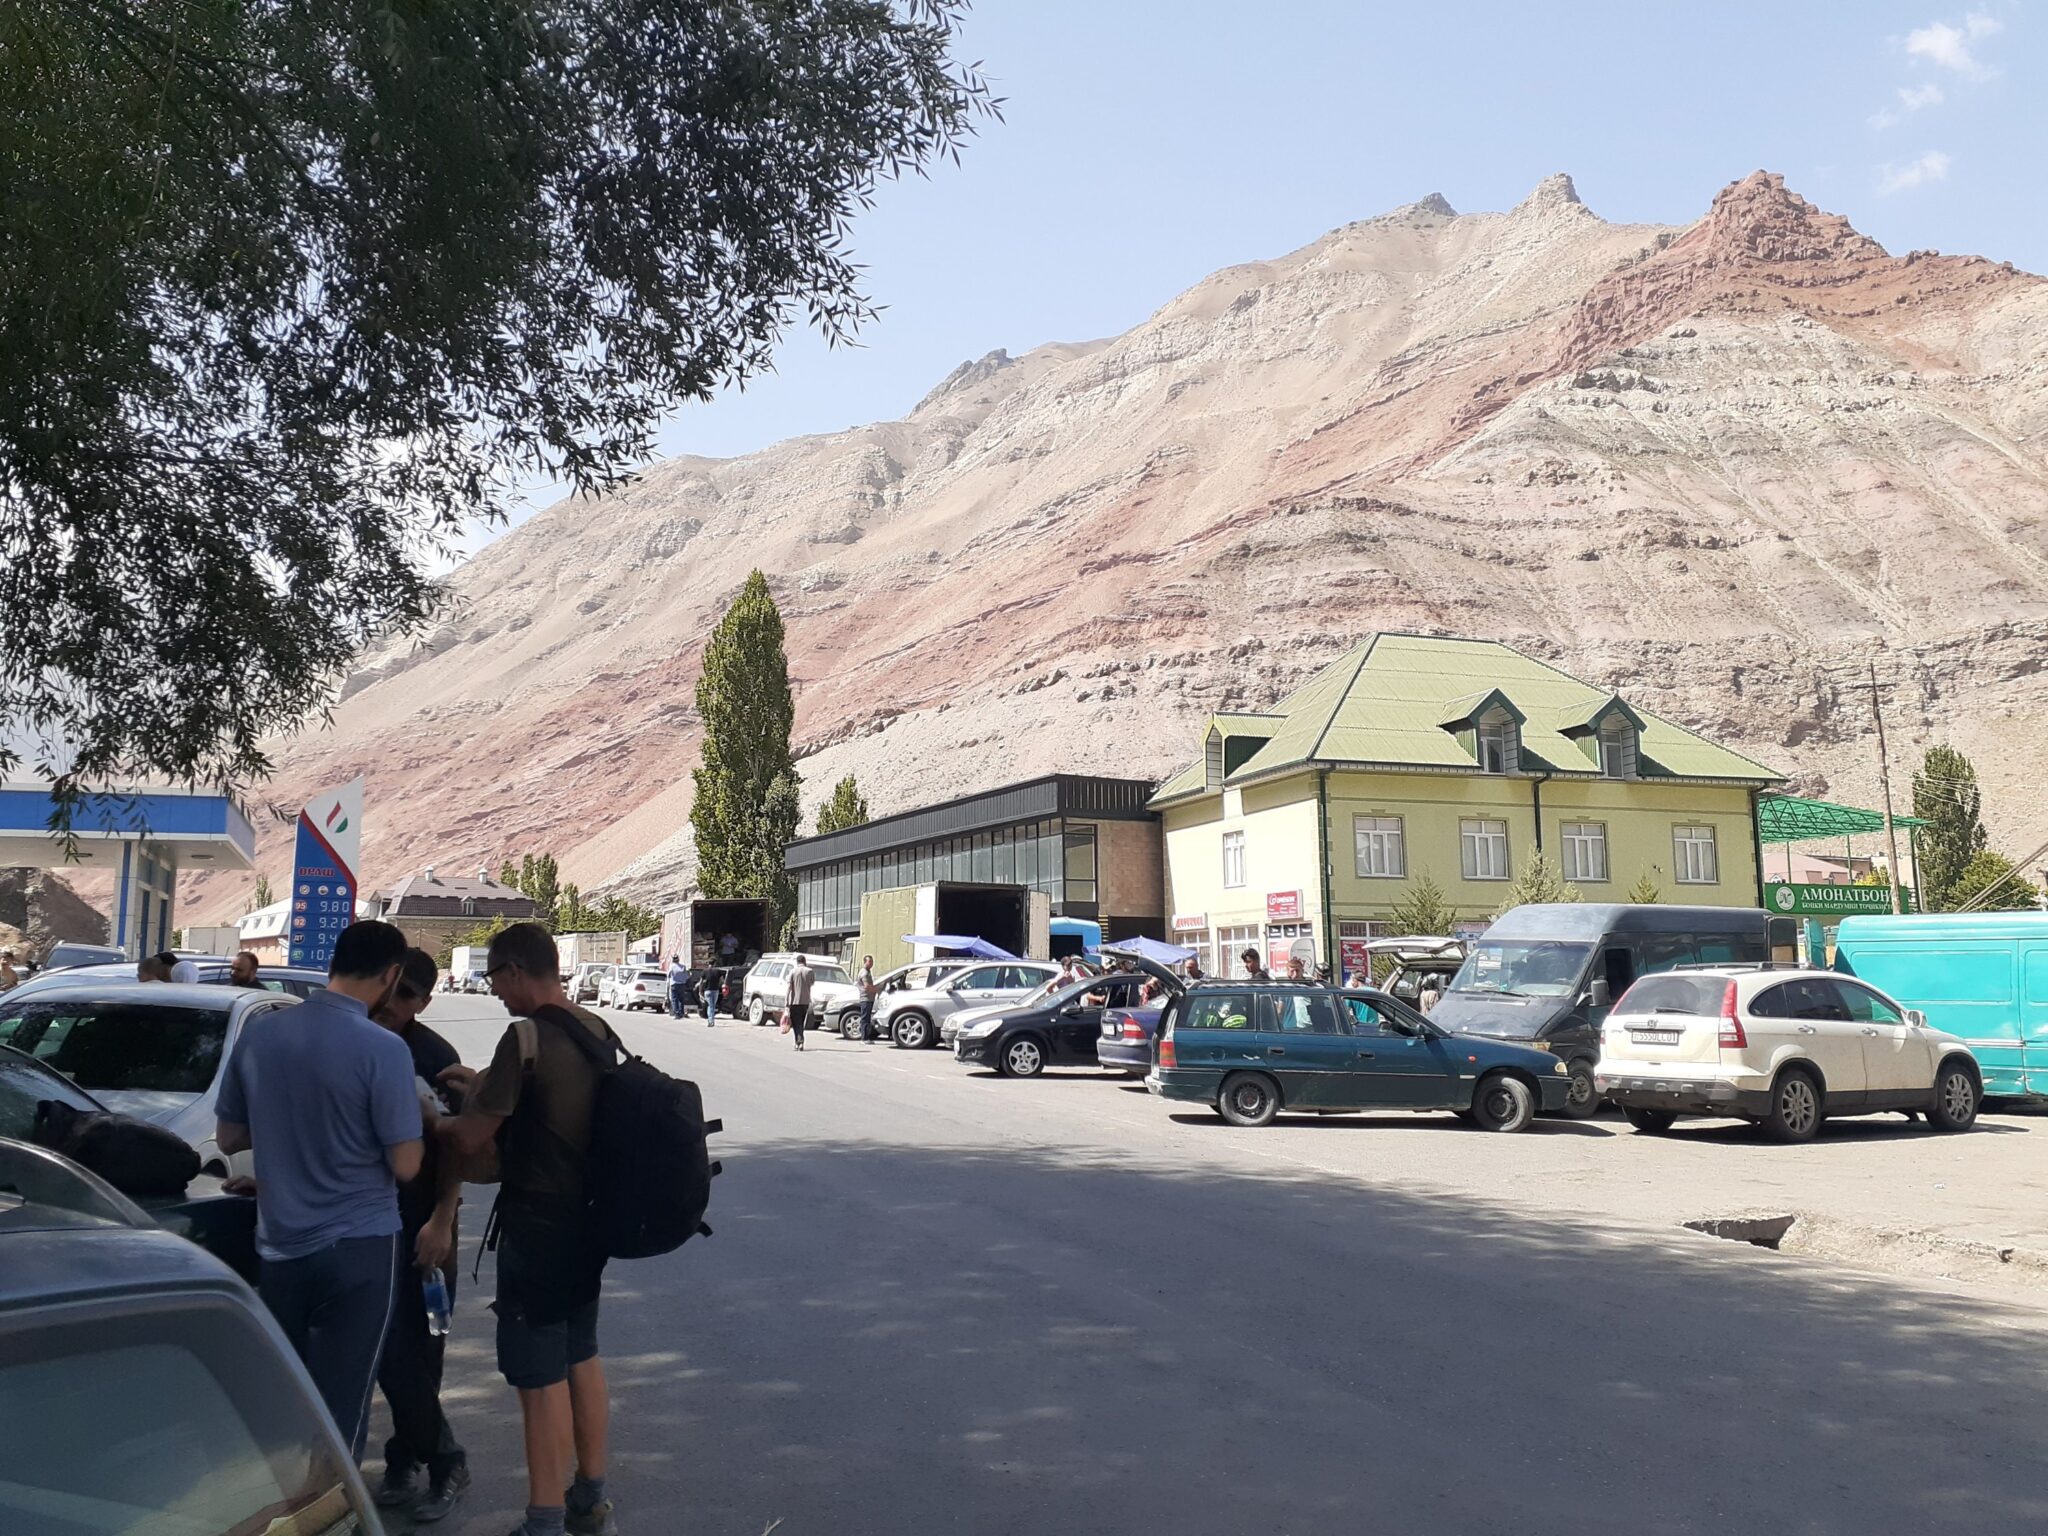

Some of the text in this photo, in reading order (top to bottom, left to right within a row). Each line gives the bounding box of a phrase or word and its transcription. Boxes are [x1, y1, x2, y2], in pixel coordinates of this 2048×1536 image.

[1801, 888, 1891, 902] АМОНАТБОН
[295, 901, 350, 912] 95 9.80
[294, 917, 349, 929] 92 9.20
[318, 933, 337, 944] 9.4
[311, 949, 335, 960] 10.2
